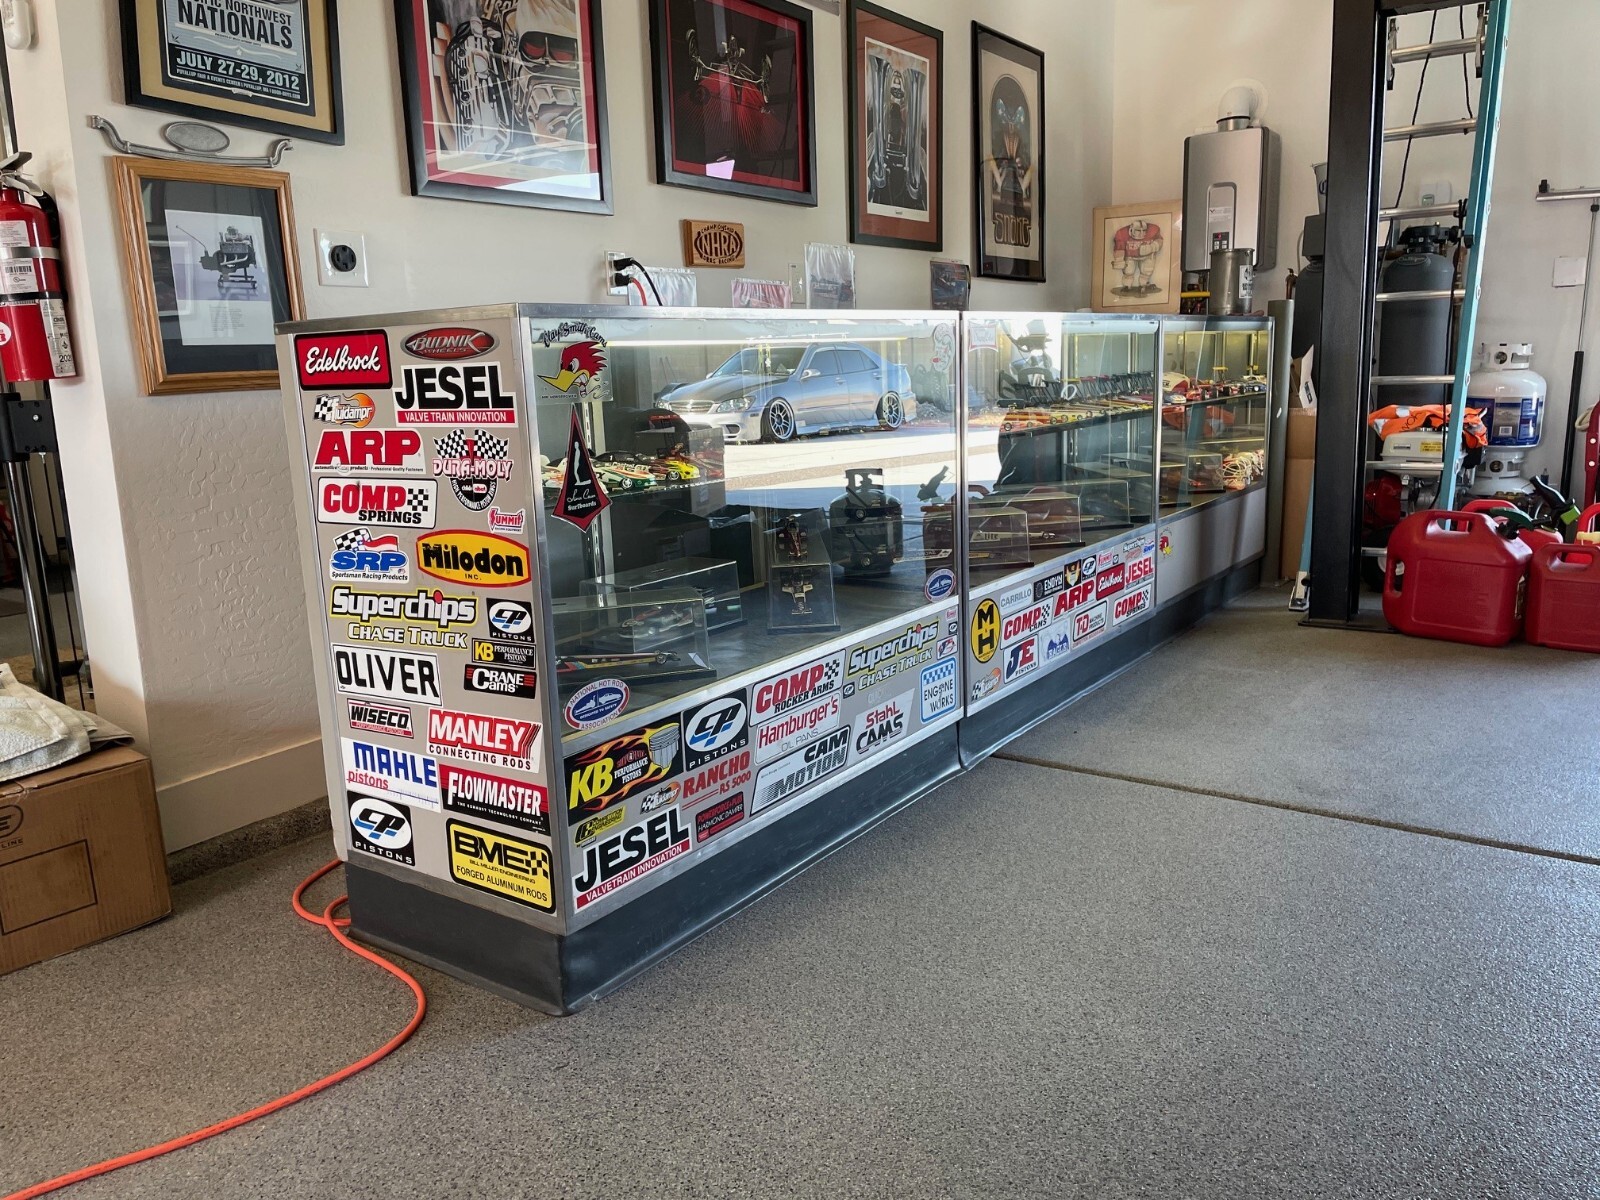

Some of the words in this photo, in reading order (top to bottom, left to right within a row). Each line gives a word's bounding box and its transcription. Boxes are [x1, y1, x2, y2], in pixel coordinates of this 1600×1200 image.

[178, 1, 292, 48] NATIONALS
[226, 0, 291, 26] NORTHWEST
[177, 51, 212, 70] JULY
[218, 60, 262, 83] 27-29,
[267, 71, 299, 90] 2012
[700, 232, 738, 257] NHRA
[412, 332, 485, 352] BUDNIK
[590, 326, 608, 347] Cams
[305, 345, 381, 374] Edelbrock
[395, 365, 514, 409] JESEL
[405, 412, 429, 421] VALVE
[430, 412, 455, 421] TRAIN
[457, 412, 506, 421] INNOVATION
[315, 431, 421, 465] ARP
[433, 459, 512, 480] DURA-MOLY
[324, 484, 406, 513] COMP
[568, 500, 596, 511] Surfboards
[359, 510, 421, 524] SPRINGS
[490, 508, 523, 528] SUMMIT
[332, 551, 408, 572] SRP
[422, 543, 524, 577] Milodon
[1126, 557, 1153, 583] JESEL
[1099, 571, 1123, 592] Edelbrock
[333, 587, 476, 626] Superchips
[1001, 588, 1031, 608] CARRILLO
[1054, 580, 1094, 617] ARP
[1115, 591, 1142, 619] COMP
[349, 623, 404, 642] CHASE
[409, 627, 468, 648] TRUCK
[492, 632, 531, 641] PISTONS
[1004, 606, 1041, 641] COMP
[1029, 620, 1047, 632] CAMS
[475, 642, 494, 661] KB
[494, 646, 533, 656] PERFORMANCE
[504, 653, 526, 662] PISTONS
[850, 623, 939, 674] Superchips
[1006, 639, 1035, 680] JE
[336, 650, 439, 697] OLIVER
[472, 668, 524, 689] CRANE
[859, 664, 896, 690] CHASE
[899, 649, 932, 670] TRUCK
[1015, 661, 1037, 676] PISTONS
[569, 684, 598, 705] NATIONAL
[598, 680, 610, 688] HOT
[611, 680, 623, 688] ROD
[756, 664, 824, 714] COMP
[774, 691, 810, 714] ROCKER
[811, 680, 834, 697] ARMS
[351, 706, 409, 729] WISECO
[580, 712, 619, 730] ASSOCIATION
[758, 696, 838, 749] Hamburger's
[430, 713, 525, 753] MANLEY
[796, 728, 819, 745] PANS
[856, 713, 903, 754] CAMS
[429, 745, 497, 764] CONNECTING
[502, 756, 532, 771] RODS
[689, 739, 746, 769] PISTONS
[804, 730, 848, 763] CAM
[353, 742, 438, 788] MAHLE
[614, 757, 649, 779] PERFORMANCE
[622, 768, 642, 784] PISTONS
[682, 751, 750, 799] RANCHO
[773, 746, 846, 797] MOTION
[348, 770, 389, 790] pistons
[569, 757, 614, 810] KB
[719, 780, 730, 795] RS
[732, 771, 751, 788] 5000
[447, 771, 541, 816] FLOWMASTER
[488, 809, 518, 819] TECHNOLOGY
[520, 815, 541, 825] COMPANY
[355, 841, 413, 865] PISTONS
[454, 830, 530, 875] BME
[575, 807, 689, 892] JESEL
[456, 865, 485, 882] FORGED
[486, 874, 525, 895] ALUMINUM
[526, 887, 548, 902] RODS
[480, 862, 498, 872] MILLER
[499, 869, 536, 884] ENGINEERING
[586, 870, 636, 902] VALVETRAIN
[637, 845, 682, 877] INNOVATION
